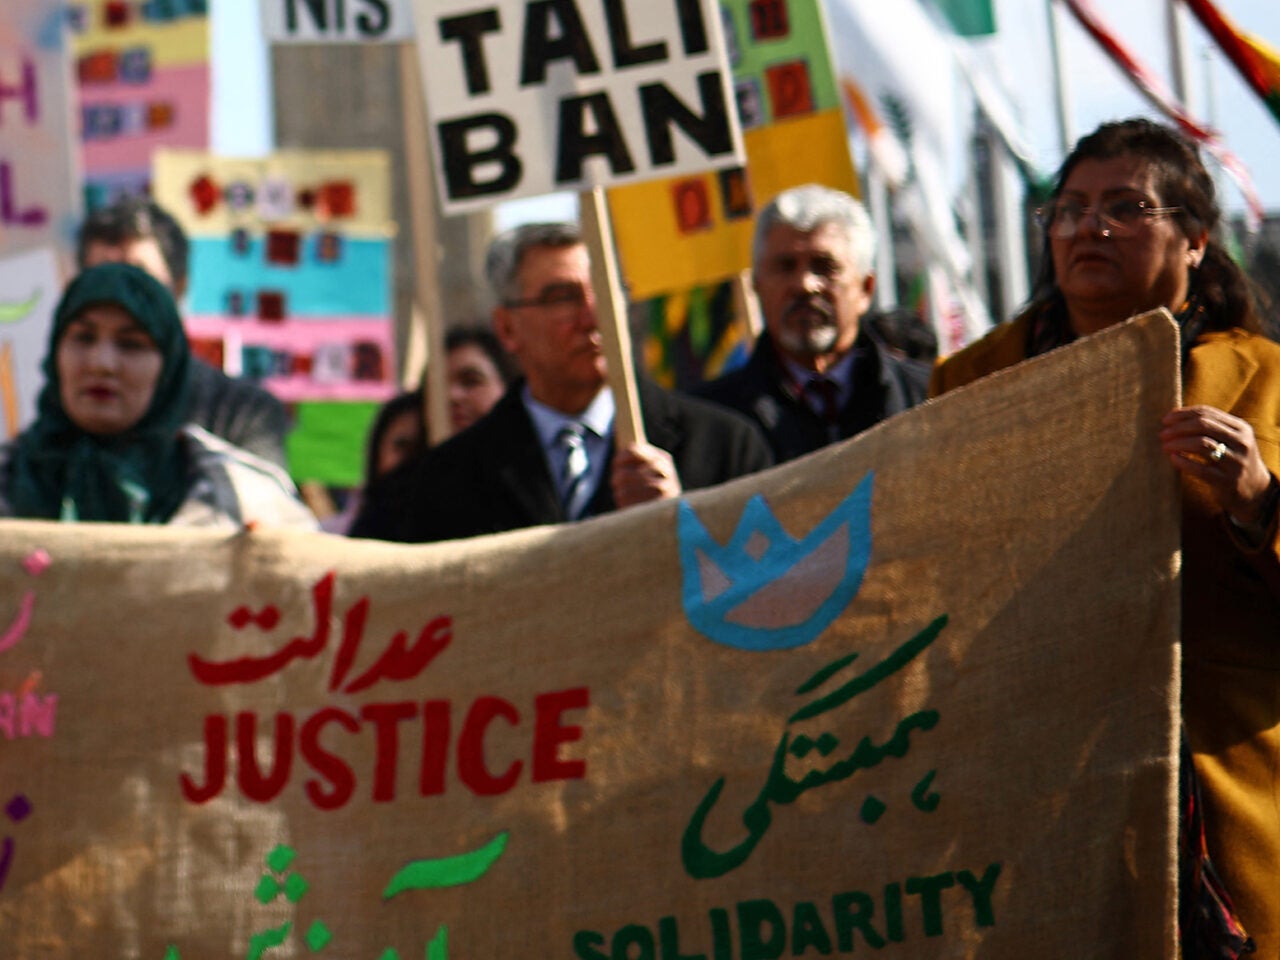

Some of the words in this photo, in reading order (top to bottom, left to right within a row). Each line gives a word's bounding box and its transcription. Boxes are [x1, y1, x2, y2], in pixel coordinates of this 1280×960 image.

[435, 70, 734, 202] BAN
[187, 570, 454, 695] عدالت
[179, 686, 590, 811] JUSTICE
[681, 613, 950, 880] همبستگی
[573, 862, 1003, 960] SOLIDARITY
